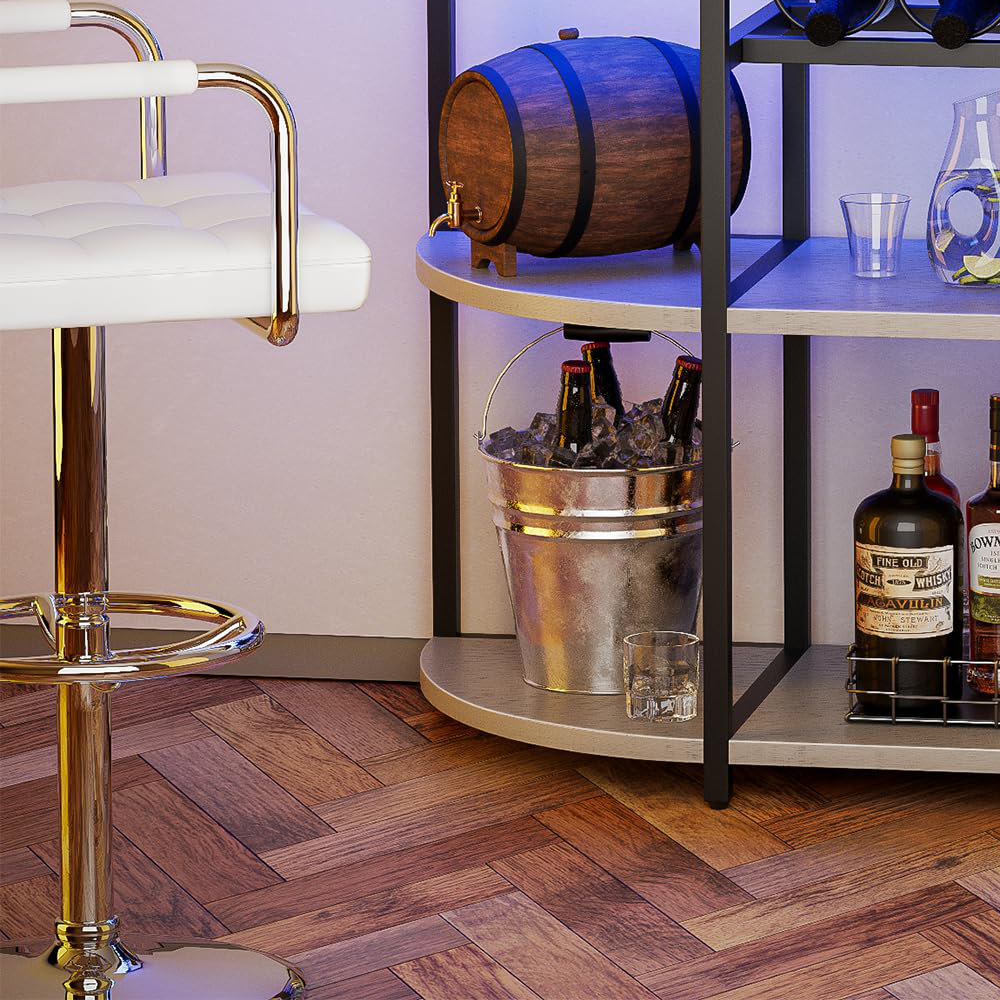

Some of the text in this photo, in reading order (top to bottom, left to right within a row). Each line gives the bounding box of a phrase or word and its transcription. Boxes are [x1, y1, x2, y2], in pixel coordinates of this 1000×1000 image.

[876, 556, 923, 568] FINE OLD
[916, 567, 952, 588] WHISKY
[900, 614, 938, 624] STEWART
